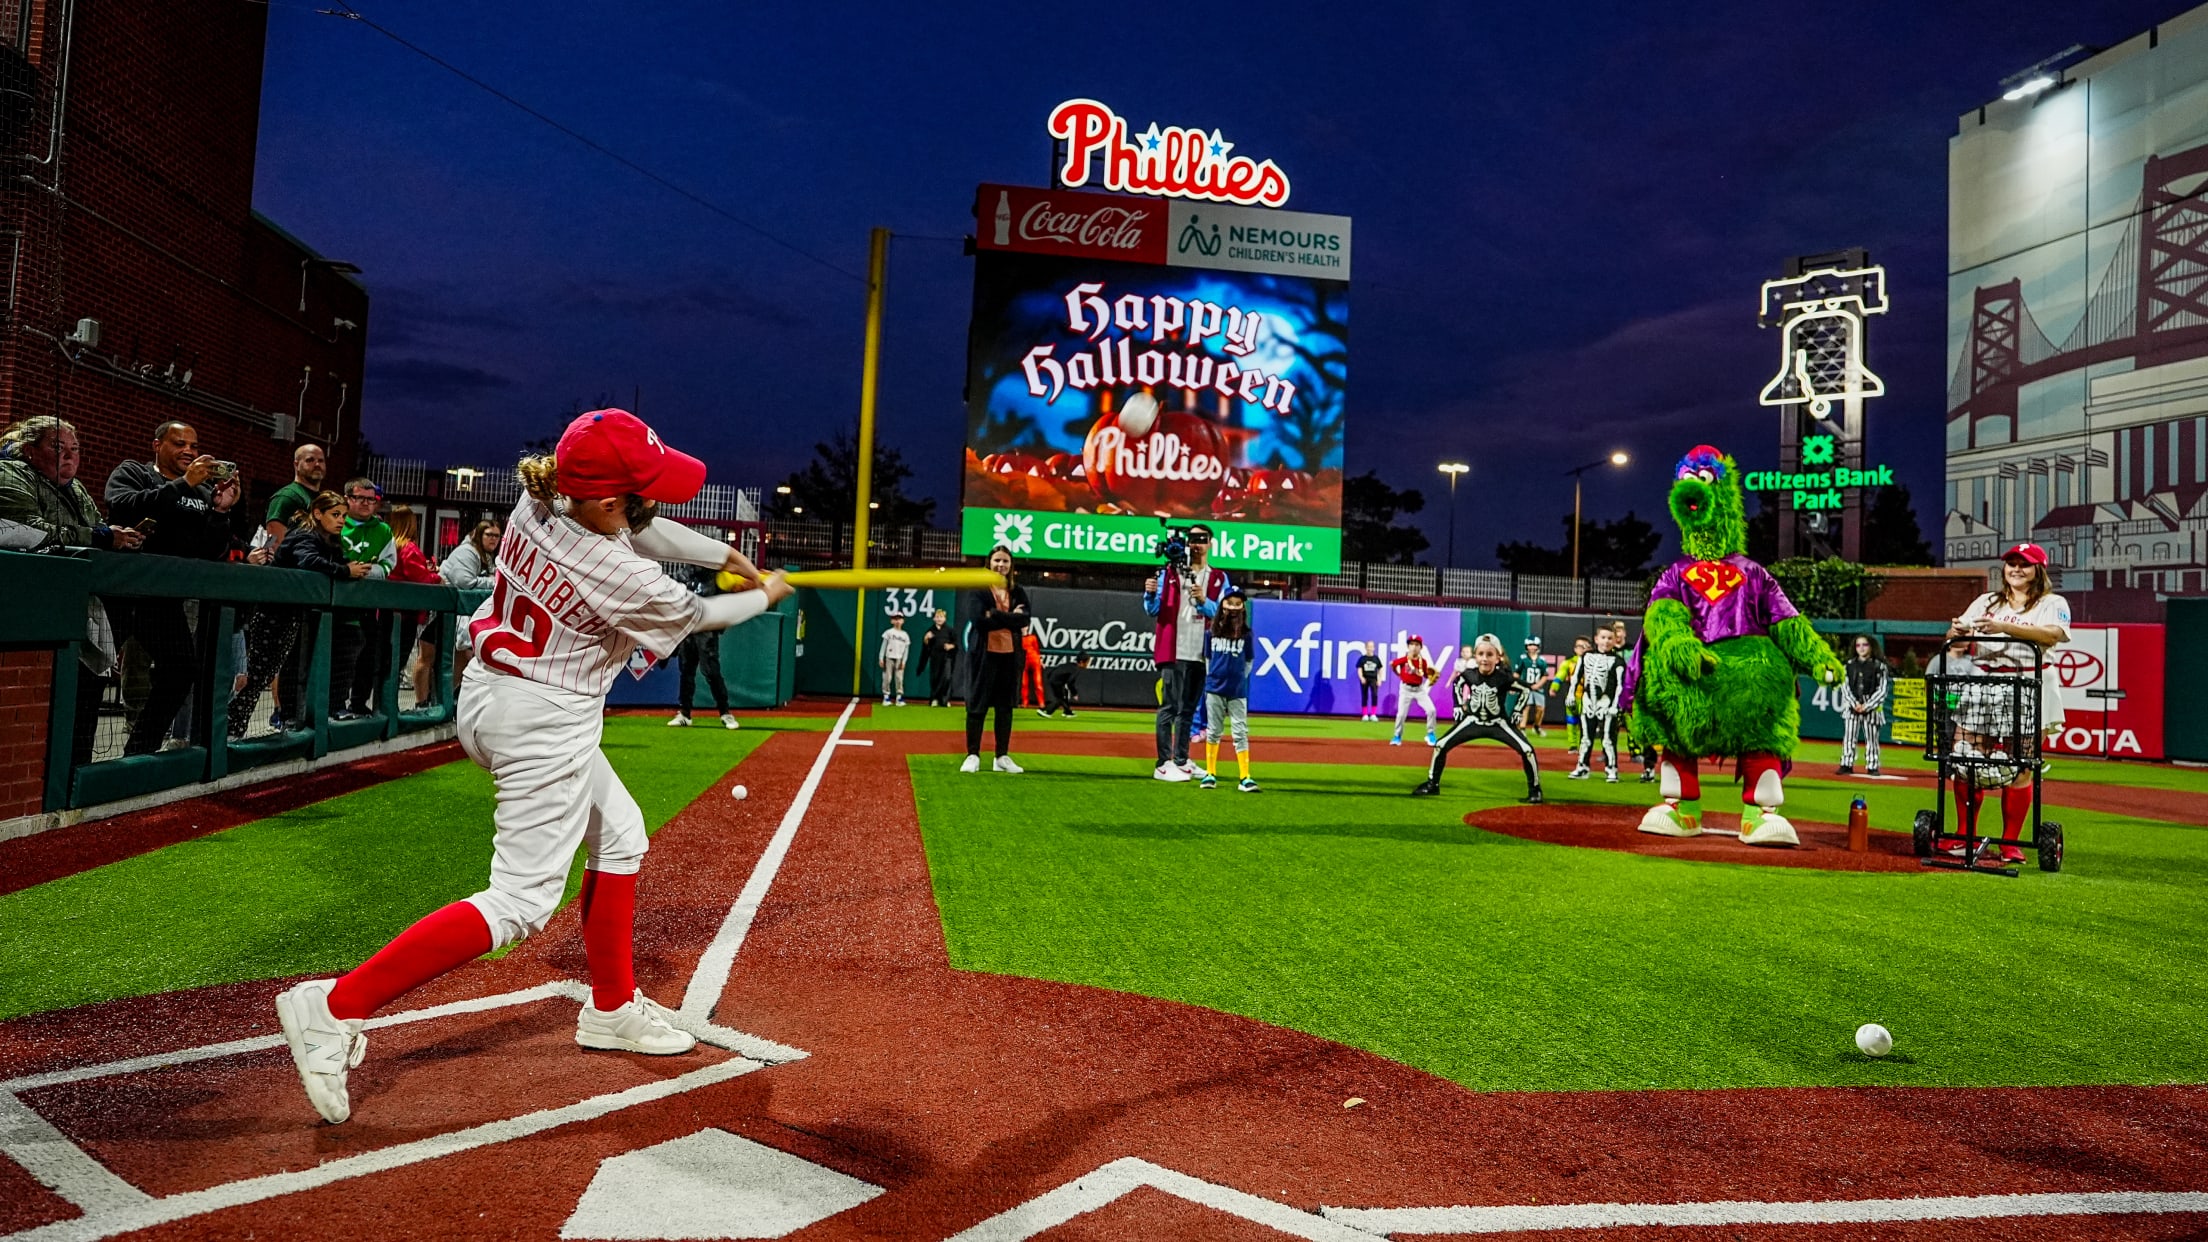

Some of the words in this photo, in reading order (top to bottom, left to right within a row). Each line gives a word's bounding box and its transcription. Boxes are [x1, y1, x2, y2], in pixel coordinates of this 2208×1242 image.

[1049, 99, 1290, 207] Phillies
[1019, 201, 1149, 249] Coca-Cola
[1229, 225, 1340, 251] NEMOURS
[1228, 246, 1295, 264] CHILDREN'S
[1297, 252, 1340, 268] HEALTH
[1065, 282, 1261, 355] Happy
[1022, 337, 1296, 414] Halloween
[1092, 426, 1223, 481] Phillies
[1743, 471, 1831, 490] Citizens
[1834, 464, 1893, 487] Bank
[1793, 488, 1843, 510] Park
[1043, 523, 1159, 554] Citizens
[884, 587, 936, 618] 334
[1255, 622, 1454, 693] xfinity
[2046, 726, 2142, 754] YOTA
